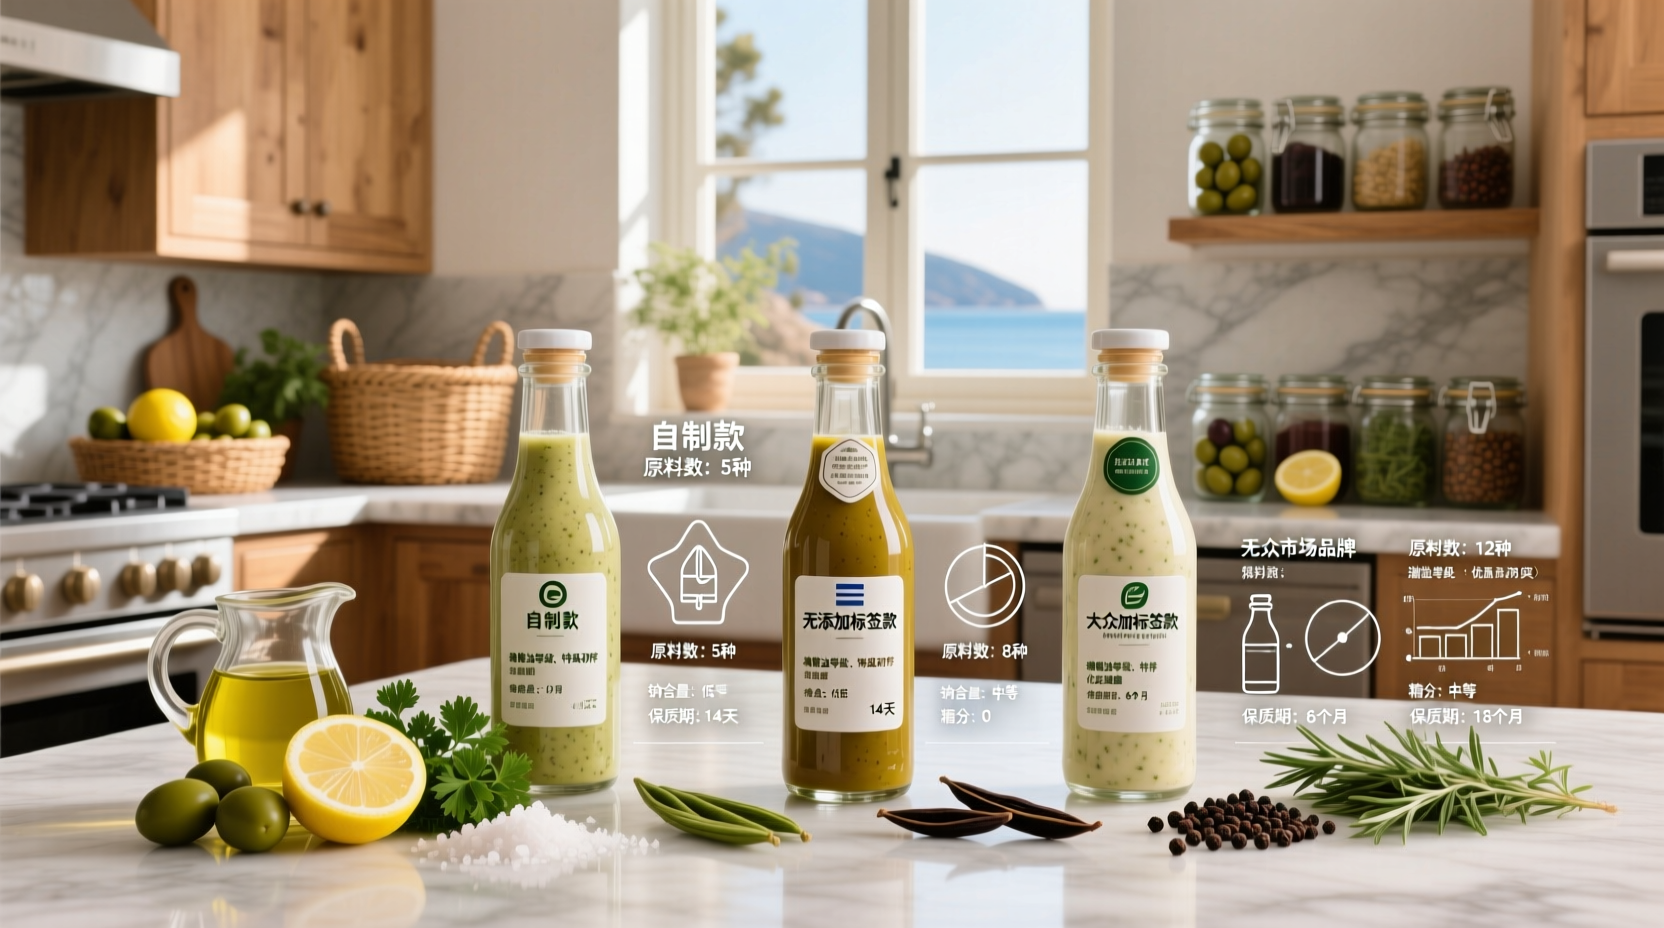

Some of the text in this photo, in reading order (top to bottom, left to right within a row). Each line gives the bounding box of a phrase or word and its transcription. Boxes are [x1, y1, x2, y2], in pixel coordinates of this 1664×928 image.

[802, 612, 897, 631] 无添加标签款
[870, 702, 896, 716] 14天
